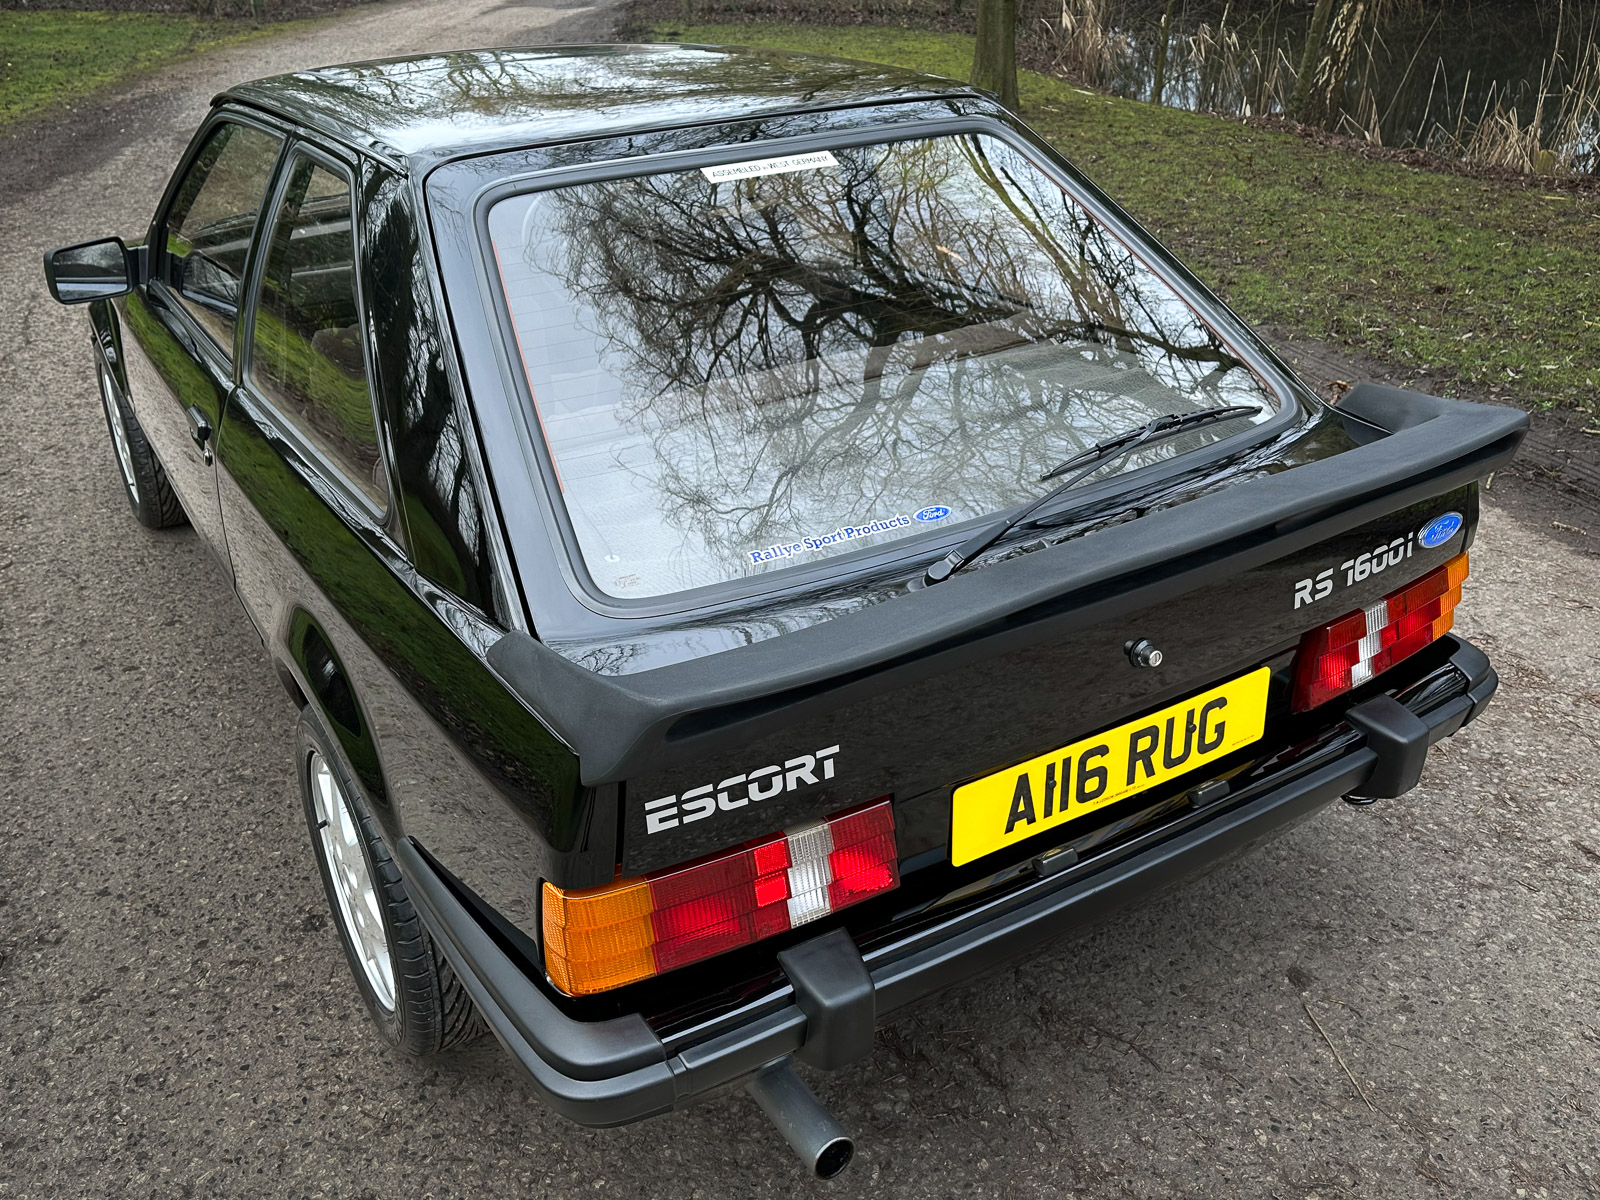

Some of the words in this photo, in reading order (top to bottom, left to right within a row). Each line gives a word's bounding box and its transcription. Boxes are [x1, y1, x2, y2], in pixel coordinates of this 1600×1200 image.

[712, 164, 761, 178] ASSEMBLED
[769, 160, 790, 170] WEST
[792, 155, 829, 166] GERMANY
[750, 542, 802, 563] Rallye
[803, 531, 844, 550] Sport
[844, 513, 910, 539] Products
[1294, 568, 1334, 610] RS
[1340, 531, 1414, 587] 1600i
[644, 744, 840, 835] ESCORT
[1004, 744, 1109, 835] A116
[1126, 696, 1228, 787] RUG
